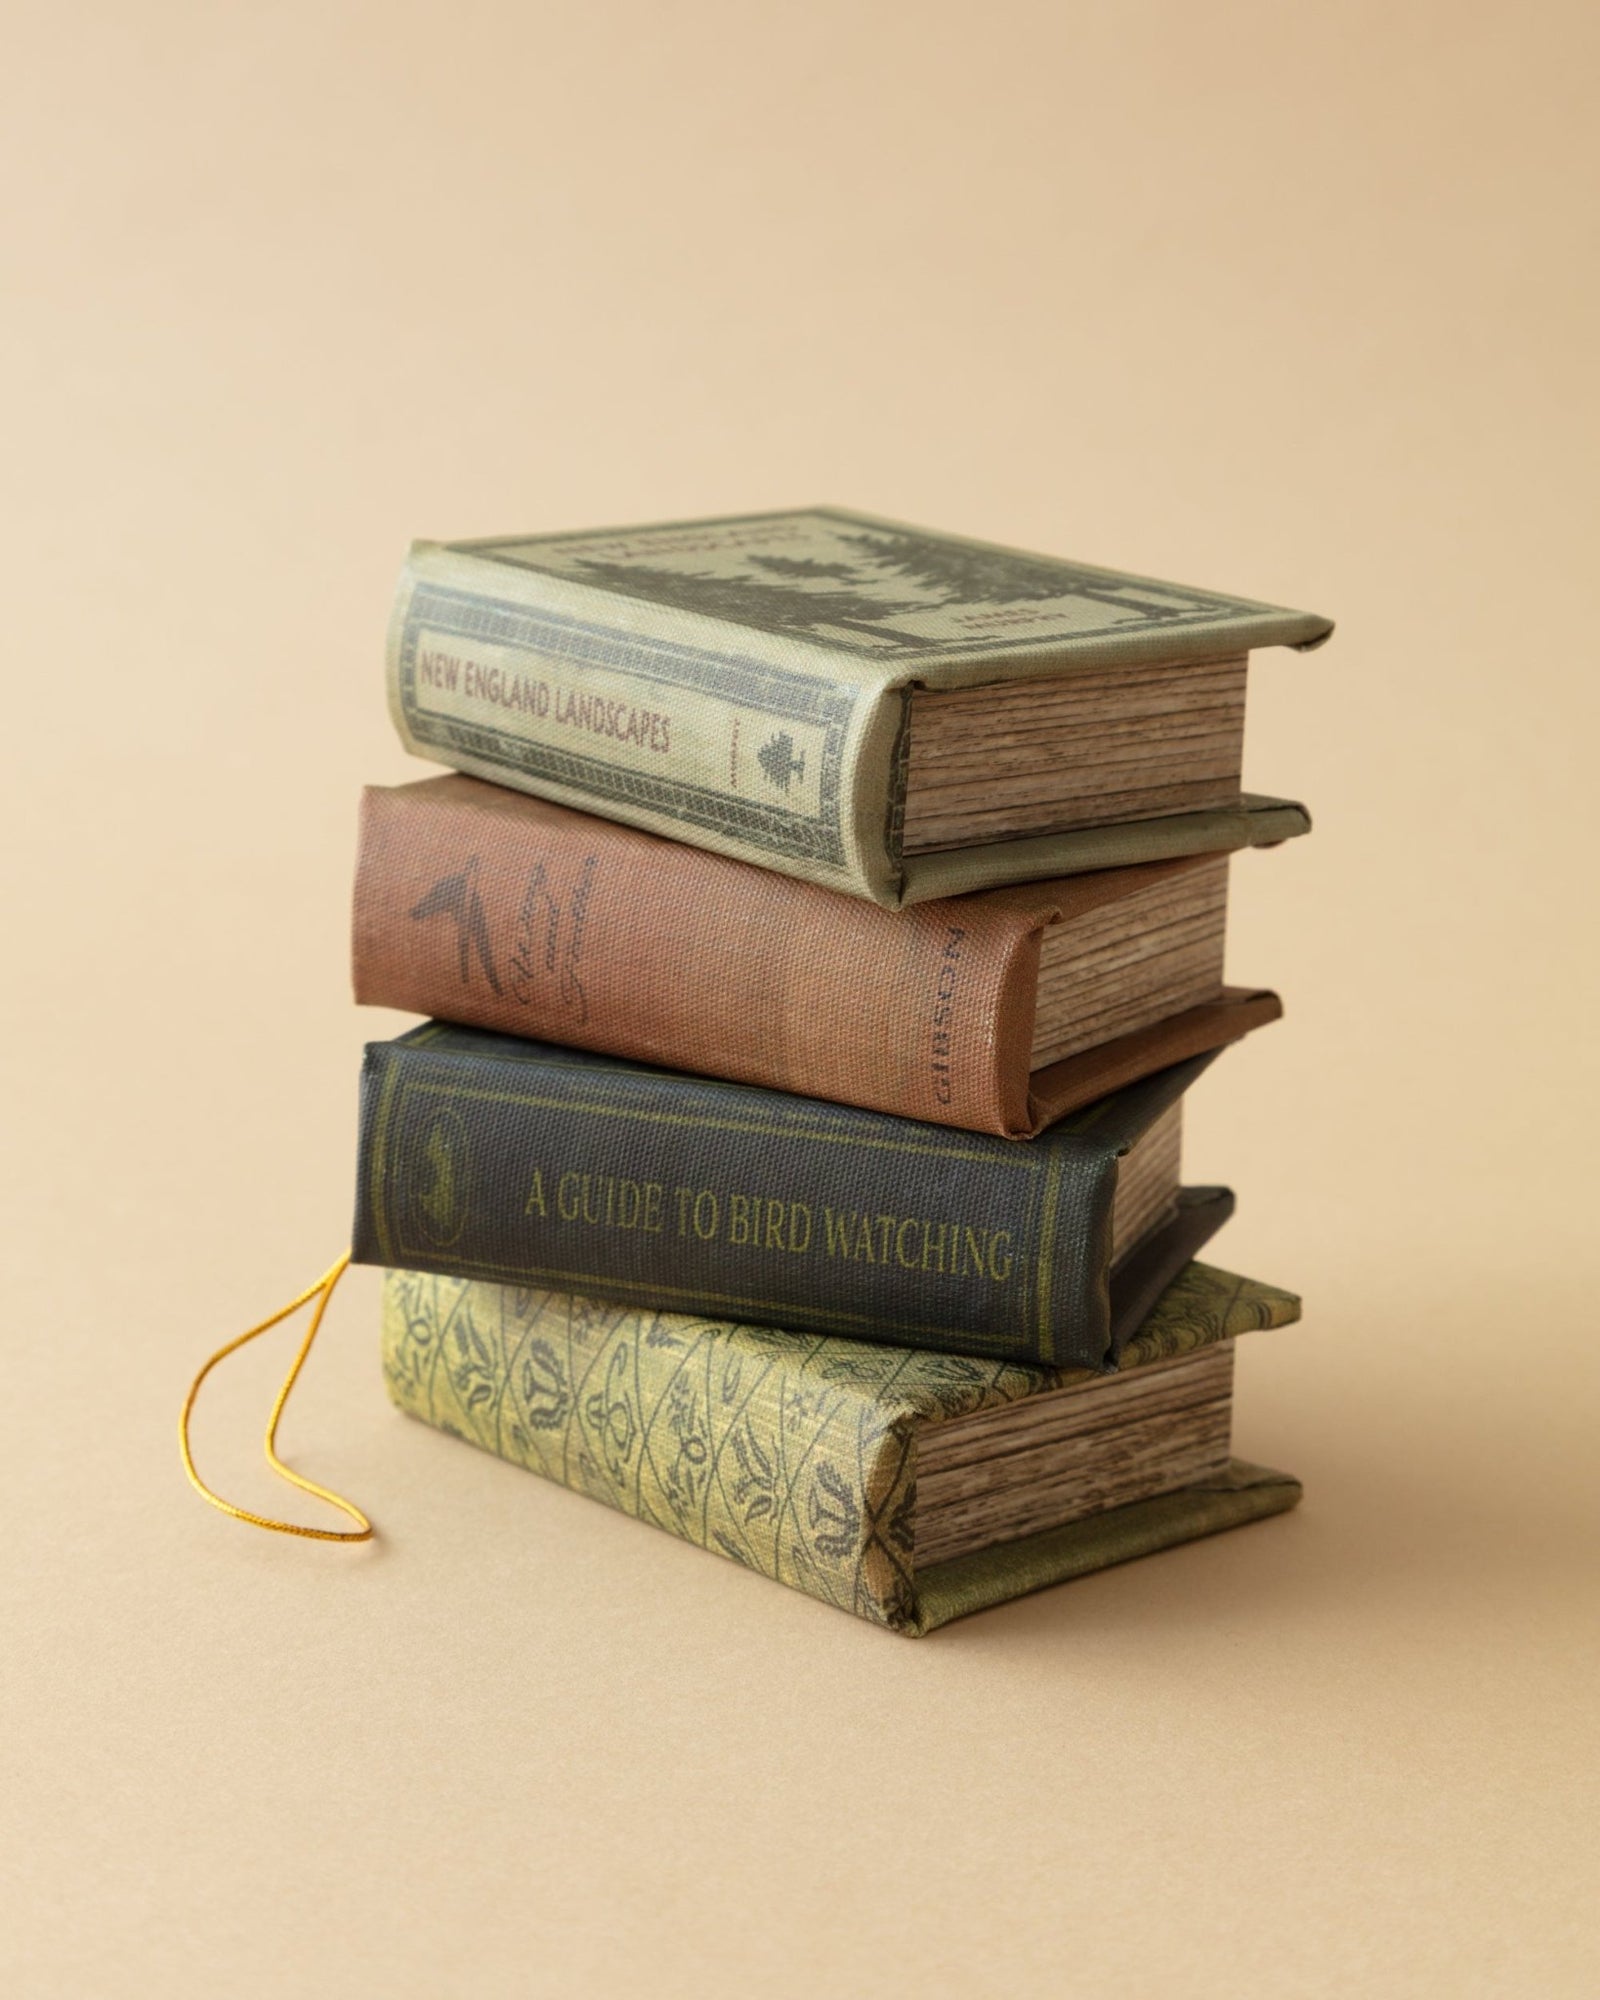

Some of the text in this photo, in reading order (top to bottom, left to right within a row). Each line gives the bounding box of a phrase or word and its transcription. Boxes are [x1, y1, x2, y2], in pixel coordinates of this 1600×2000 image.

[421, 650, 459, 692] NEW
[464, 663, 550, 718] ENGLAND
[555, 690, 671, 754] LANDSCAPES
[525, 1171, 1013, 1282] A GUIDE TO BIRD WATCHING
